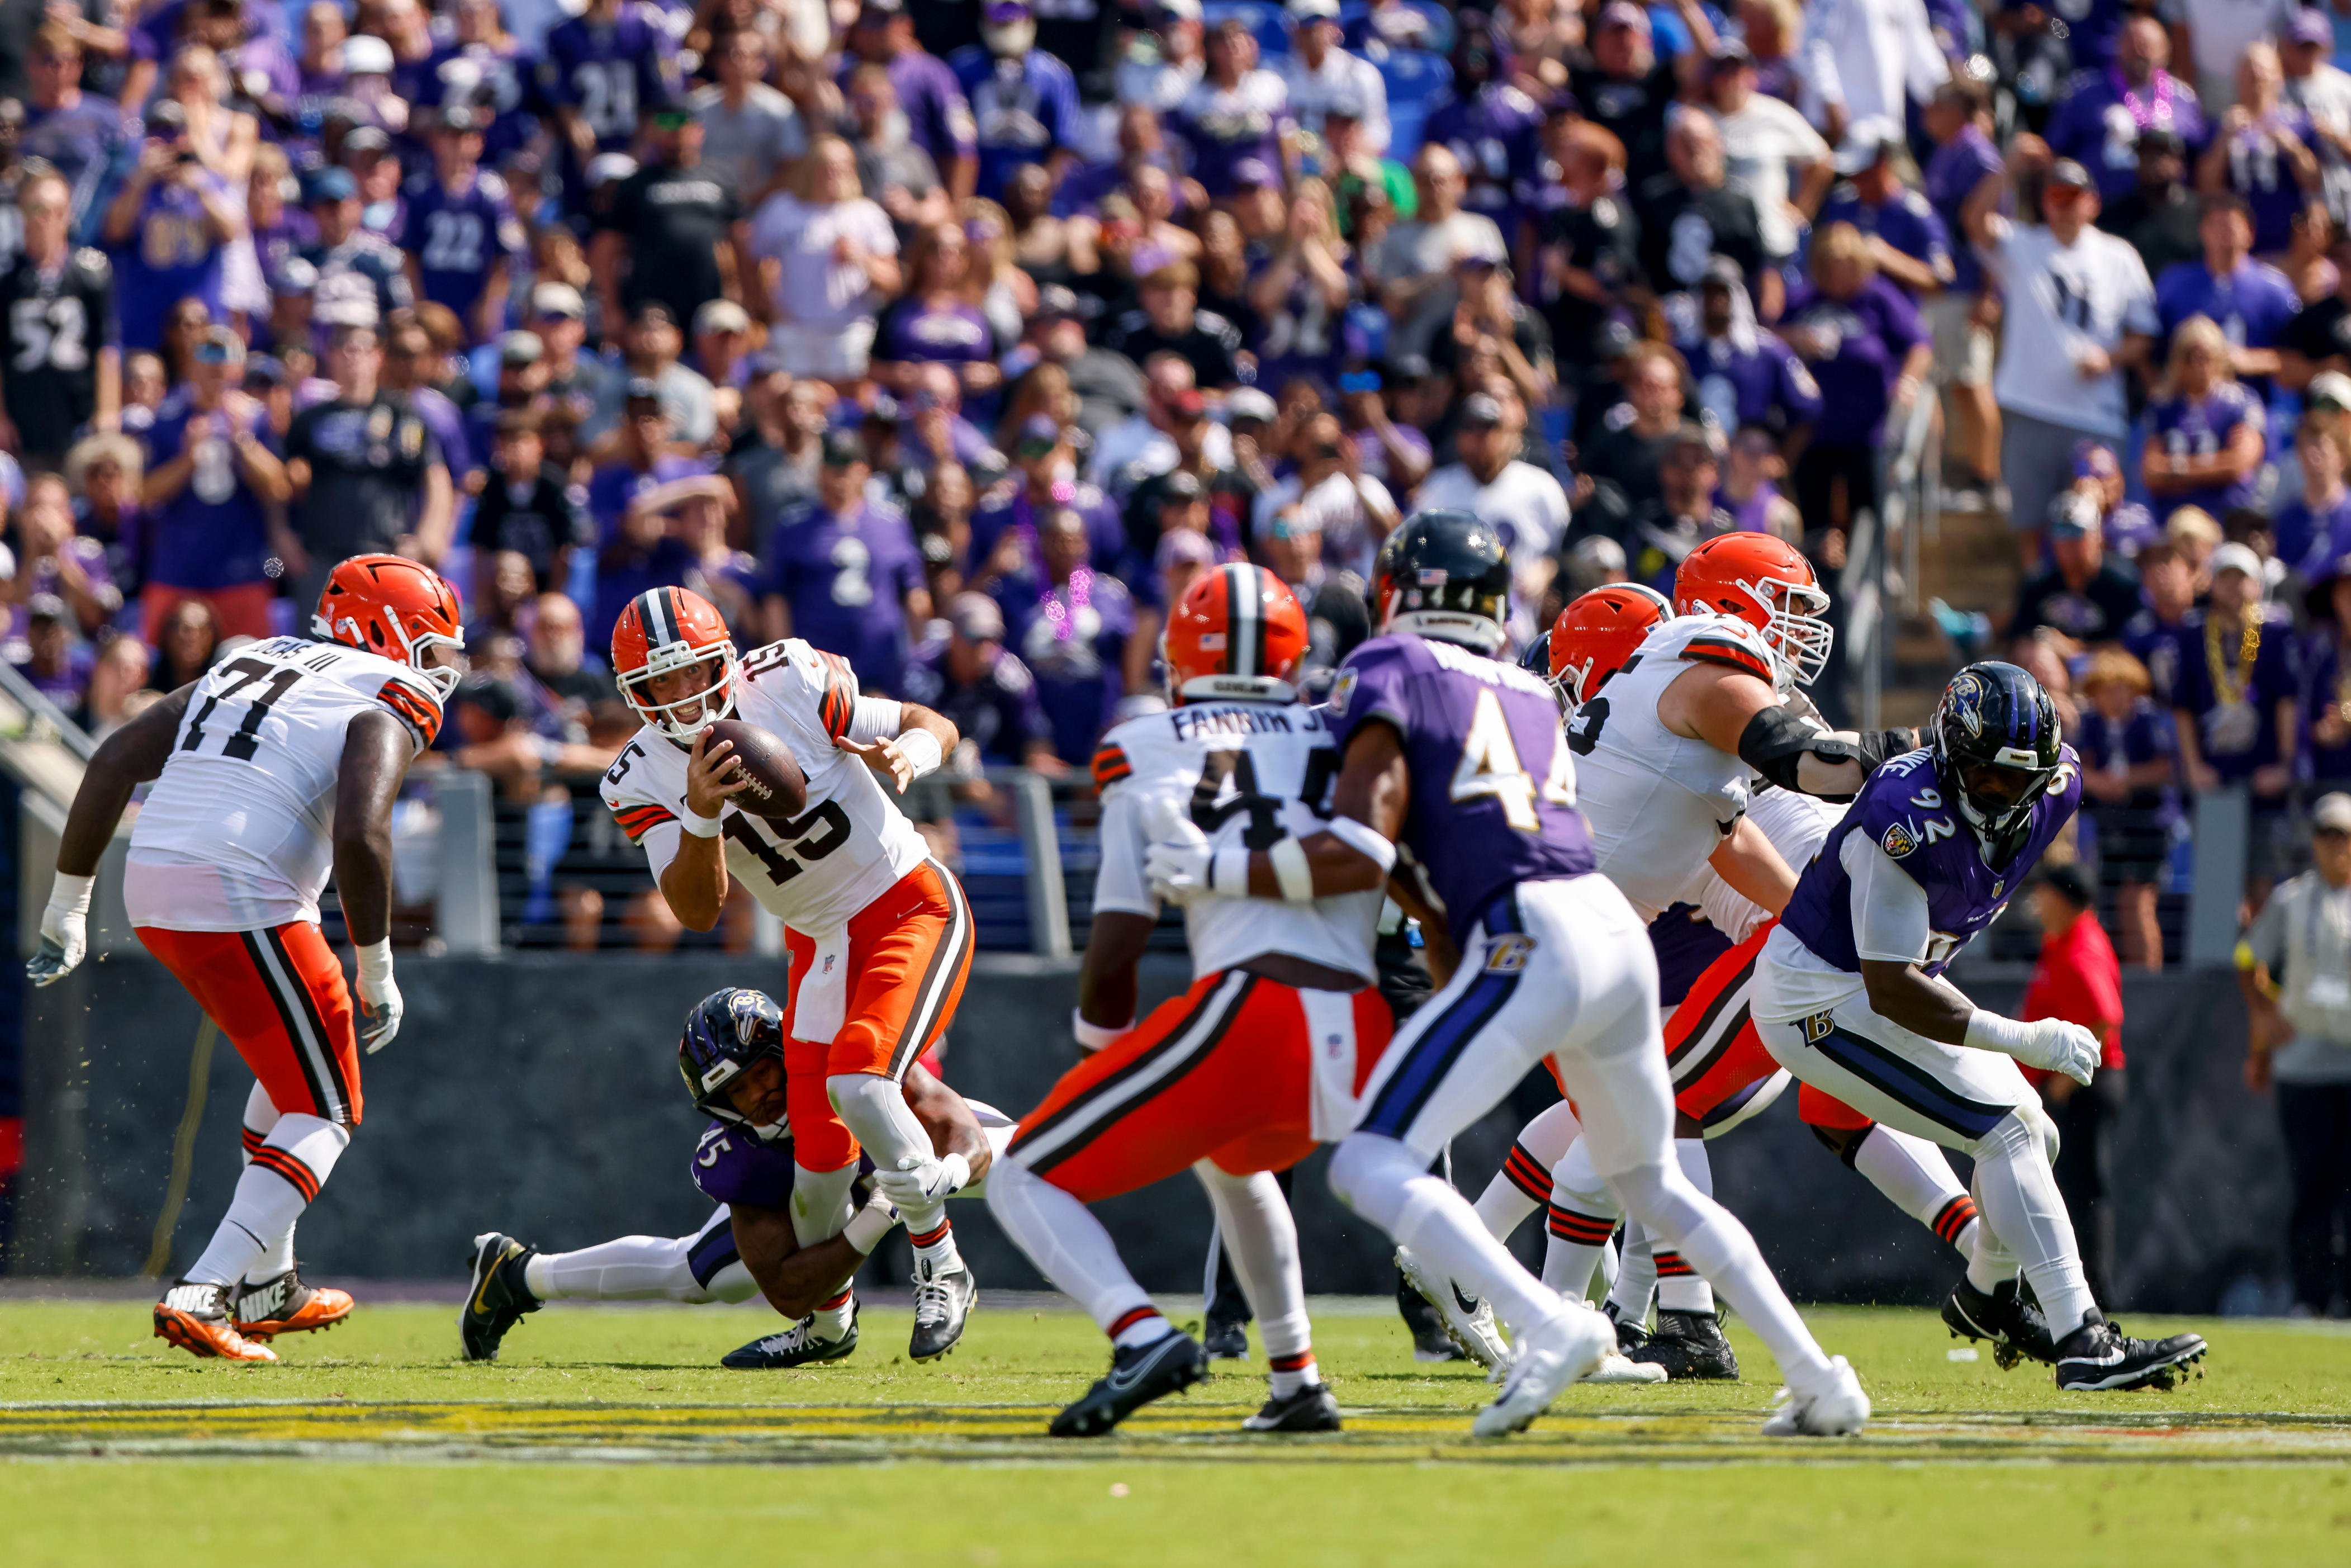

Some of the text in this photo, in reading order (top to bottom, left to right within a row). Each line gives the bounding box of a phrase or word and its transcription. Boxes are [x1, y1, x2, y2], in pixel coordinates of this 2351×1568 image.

[9, 295, 90, 372] 52
[828, 536, 874, 608] 2
[304, 652, 343, 672] III
[742, 642, 790, 682] 15
[181, 657, 303, 761] 71
[680, 766, 851, 887] 15
[1895, 826, 1914, 847] RAVENS
[1909, 786, 1956, 846] 92
[696, 1126, 733, 1168] 45
[165, 1285, 219, 1314] NIKE
[239, 1278, 287, 1324] NIKE
